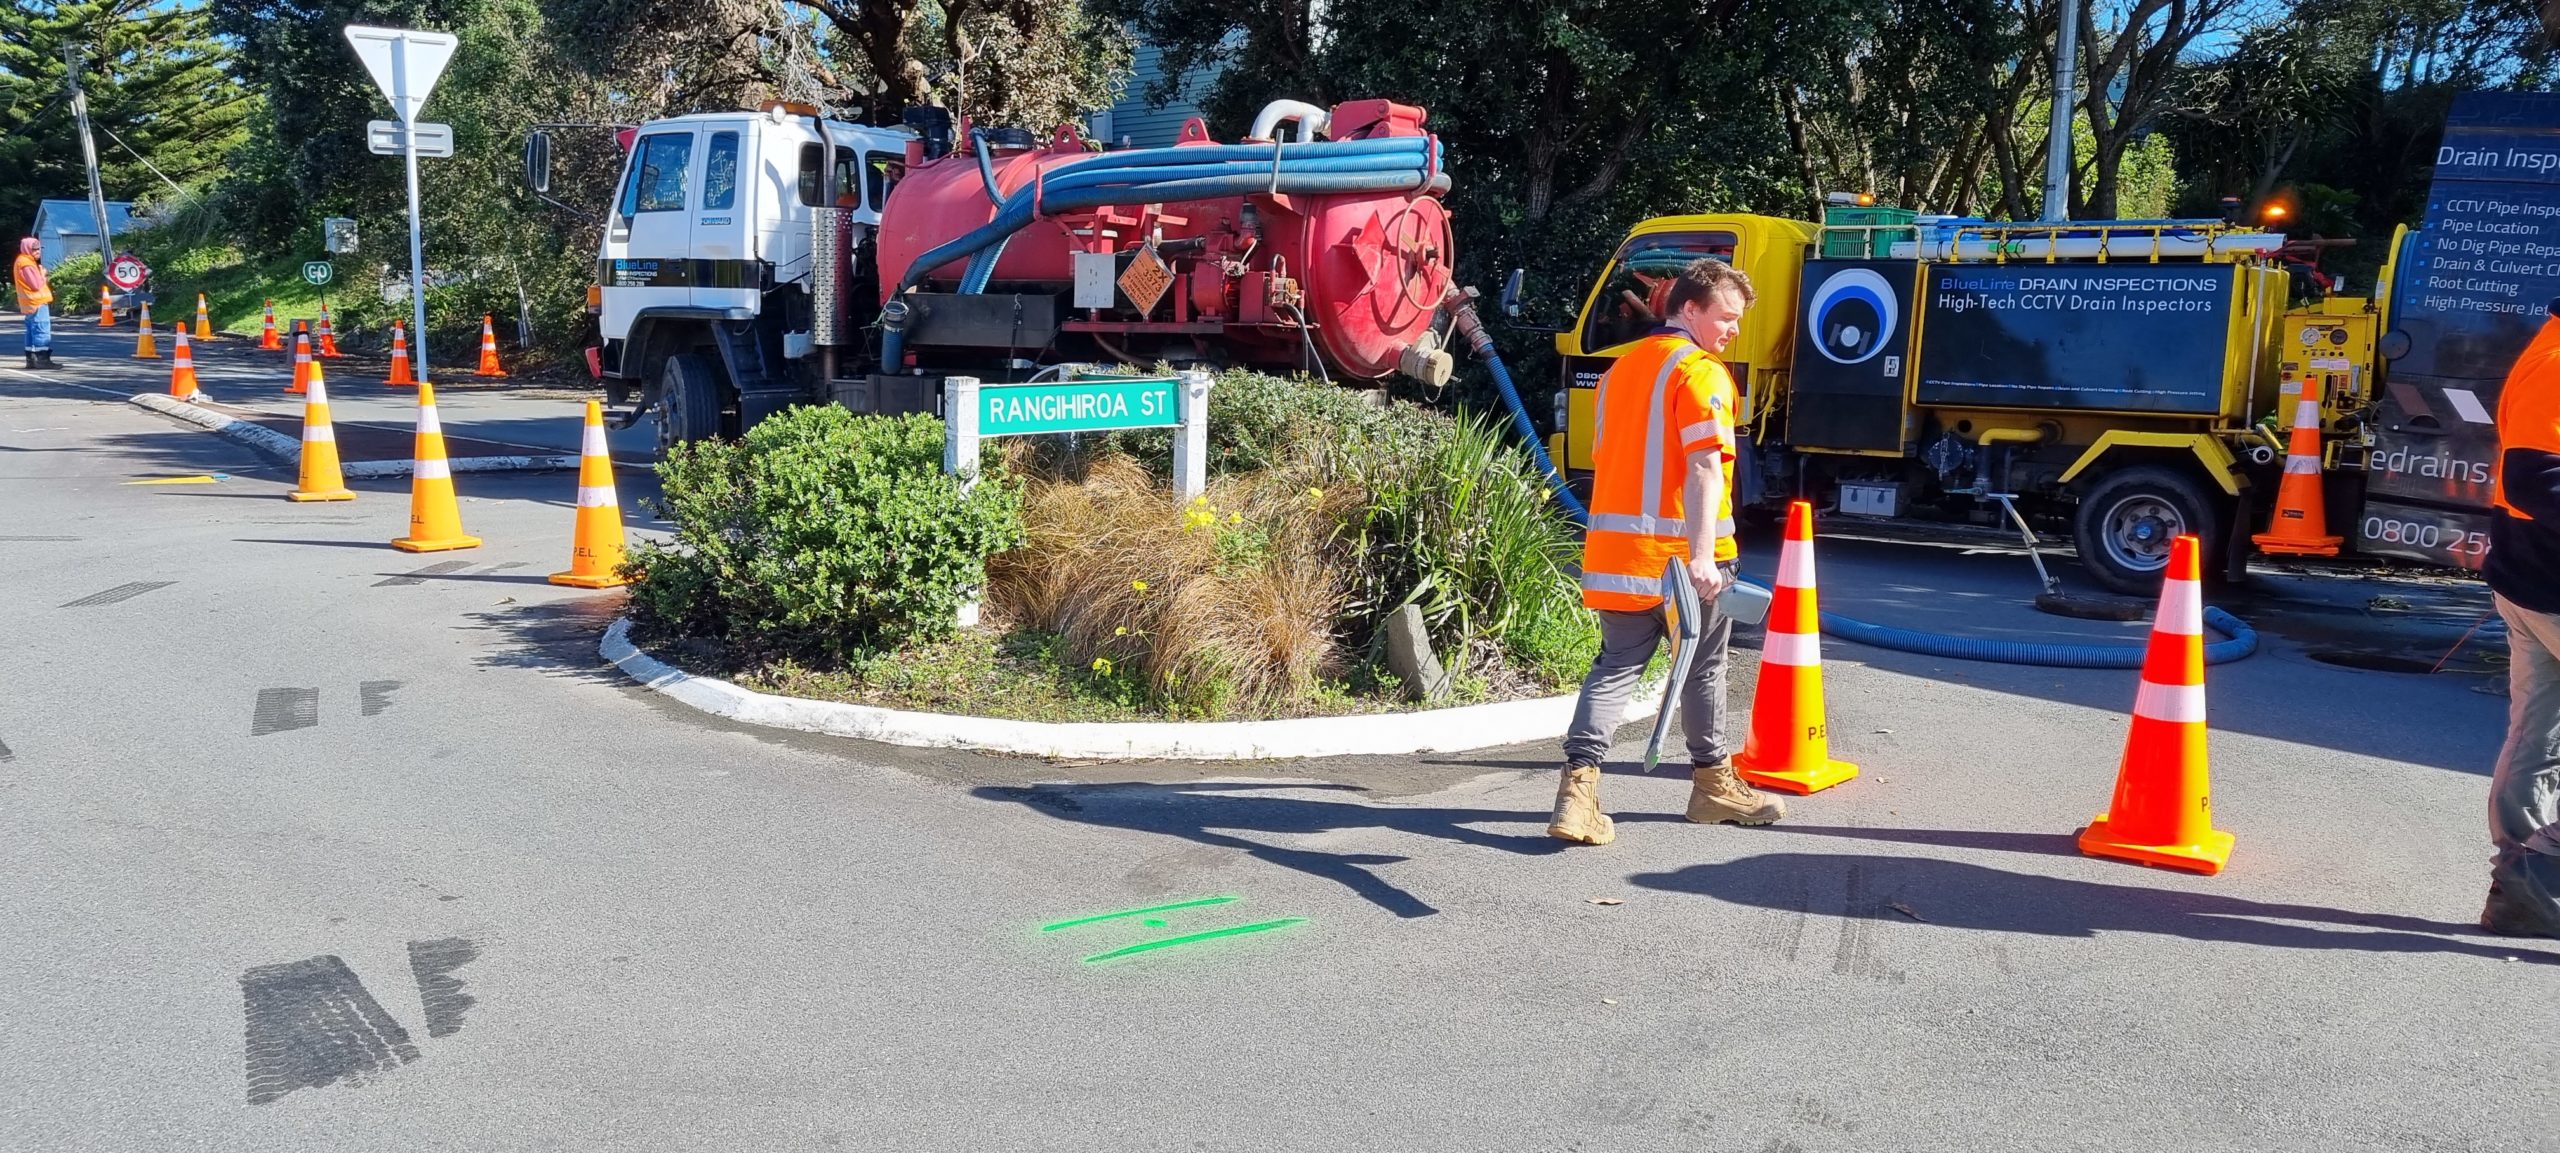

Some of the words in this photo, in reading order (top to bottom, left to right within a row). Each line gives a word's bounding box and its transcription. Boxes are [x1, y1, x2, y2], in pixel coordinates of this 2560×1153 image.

[2437, 146, 2499, 166] Drain
[2506, 148, 2560, 174] Insp
[2447, 200, 2485, 213] CCTV
[2487, 201, 2520, 217] Pipe
[2442, 219, 2473, 234] Pipe
[2476, 220, 2539, 235] Location
[2437, 238, 2458, 250] No
[2461, 239, 2486, 255] Dig
[2488, 240, 2520, 257] Pipe
[118, 266, 138, 279] 50
[309, 265, 327, 278] GO
[2433, 257, 2471, 271] Drain
[2474, 259, 2486, 272] &
[2490, 260, 2544, 276] Culvert
[1941, 278, 2015, 290] BlueLine
[2019, 278, 2078, 290] DRAIN
[2083, 278, 2217, 292] INSPECTIONS
[2429, 276, 2463, 290] Root
[2466, 278, 2520, 297] Cutting
[1939, 293, 2016, 313] High-Tech
[2020, 294, 2065, 310] CCTV
[2070, 295, 2116, 311] Drain
[2122, 295, 2212, 315] Inspectors
[2424, 295, 2457, 312] High
[2460, 297, 2525, 315] Pressure
[2528, 303, 2550, 317] Jet
[990, 392, 1128, 423] RANGIHIROA
[1141, 391, 1167, 416] ST
[2370, 445, 2495, 484] edrains.
[2364, 517, 2439, 548] 0800
[1808, 724, 1826, 740] P.E
